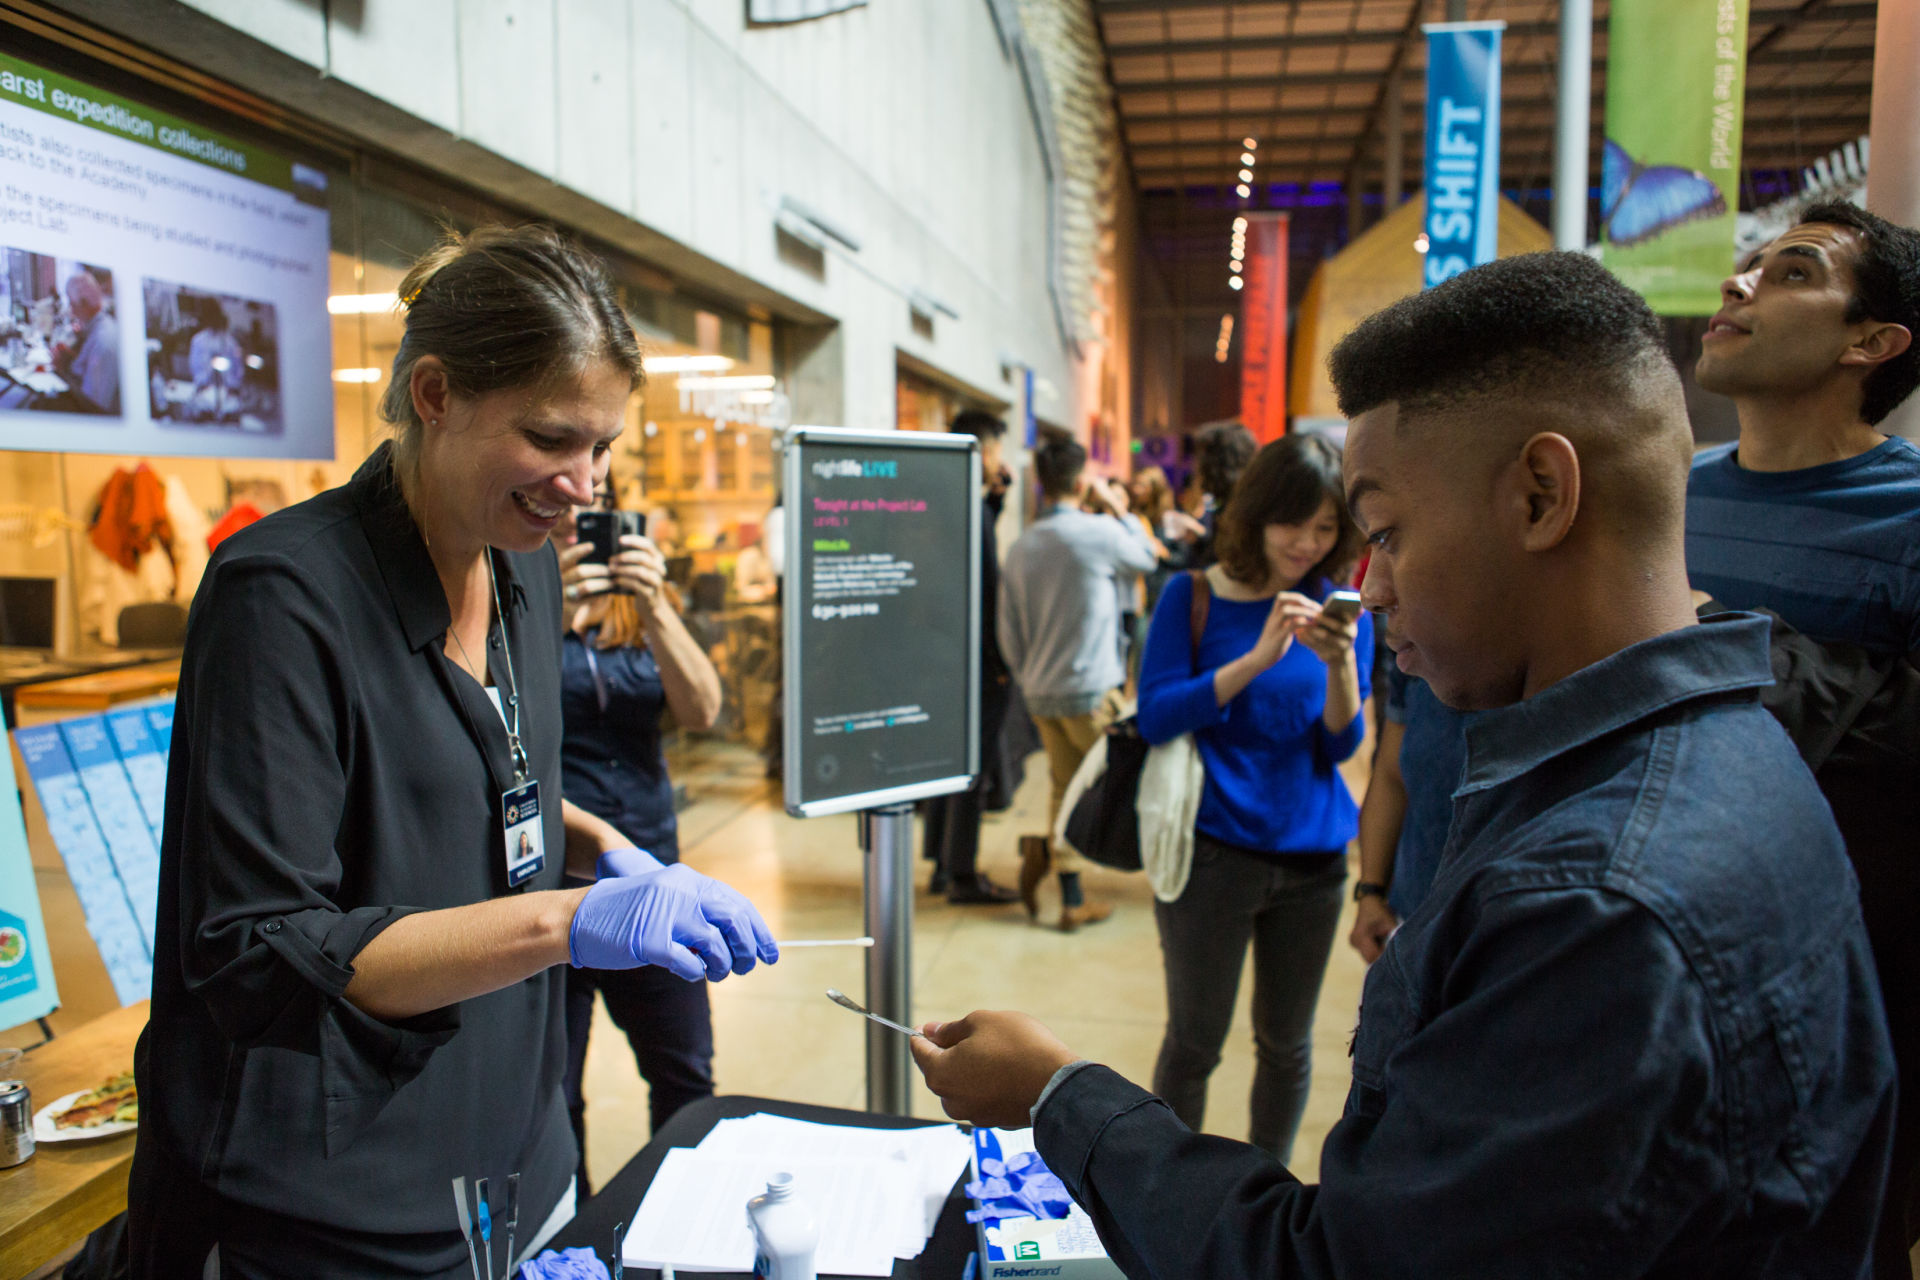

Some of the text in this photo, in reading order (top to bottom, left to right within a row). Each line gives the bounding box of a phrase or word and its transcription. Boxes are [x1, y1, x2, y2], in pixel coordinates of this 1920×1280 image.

[1716, 36, 1738, 59] of
[1713, 64, 1736, 100] the
[0, 70, 247, 172] arst expedition collections
[1709, 102, 1734, 169] World
[28, 150, 45, 170] to
[50, 156, 75, 179] the
[80, 165, 147, 202] Academy
[40, 136, 73, 158] also
[77, 147, 143, 180] collected
[145, 168, 213, 199] specimens
[1430, 98, 1482, 243] SHIFT
[5, 183, 33, 206] the
[37, 194, 120, 229] specimens
[123, 214, 162, 240] being
[992, 1264, 1062, 1279] Fisherbrand
